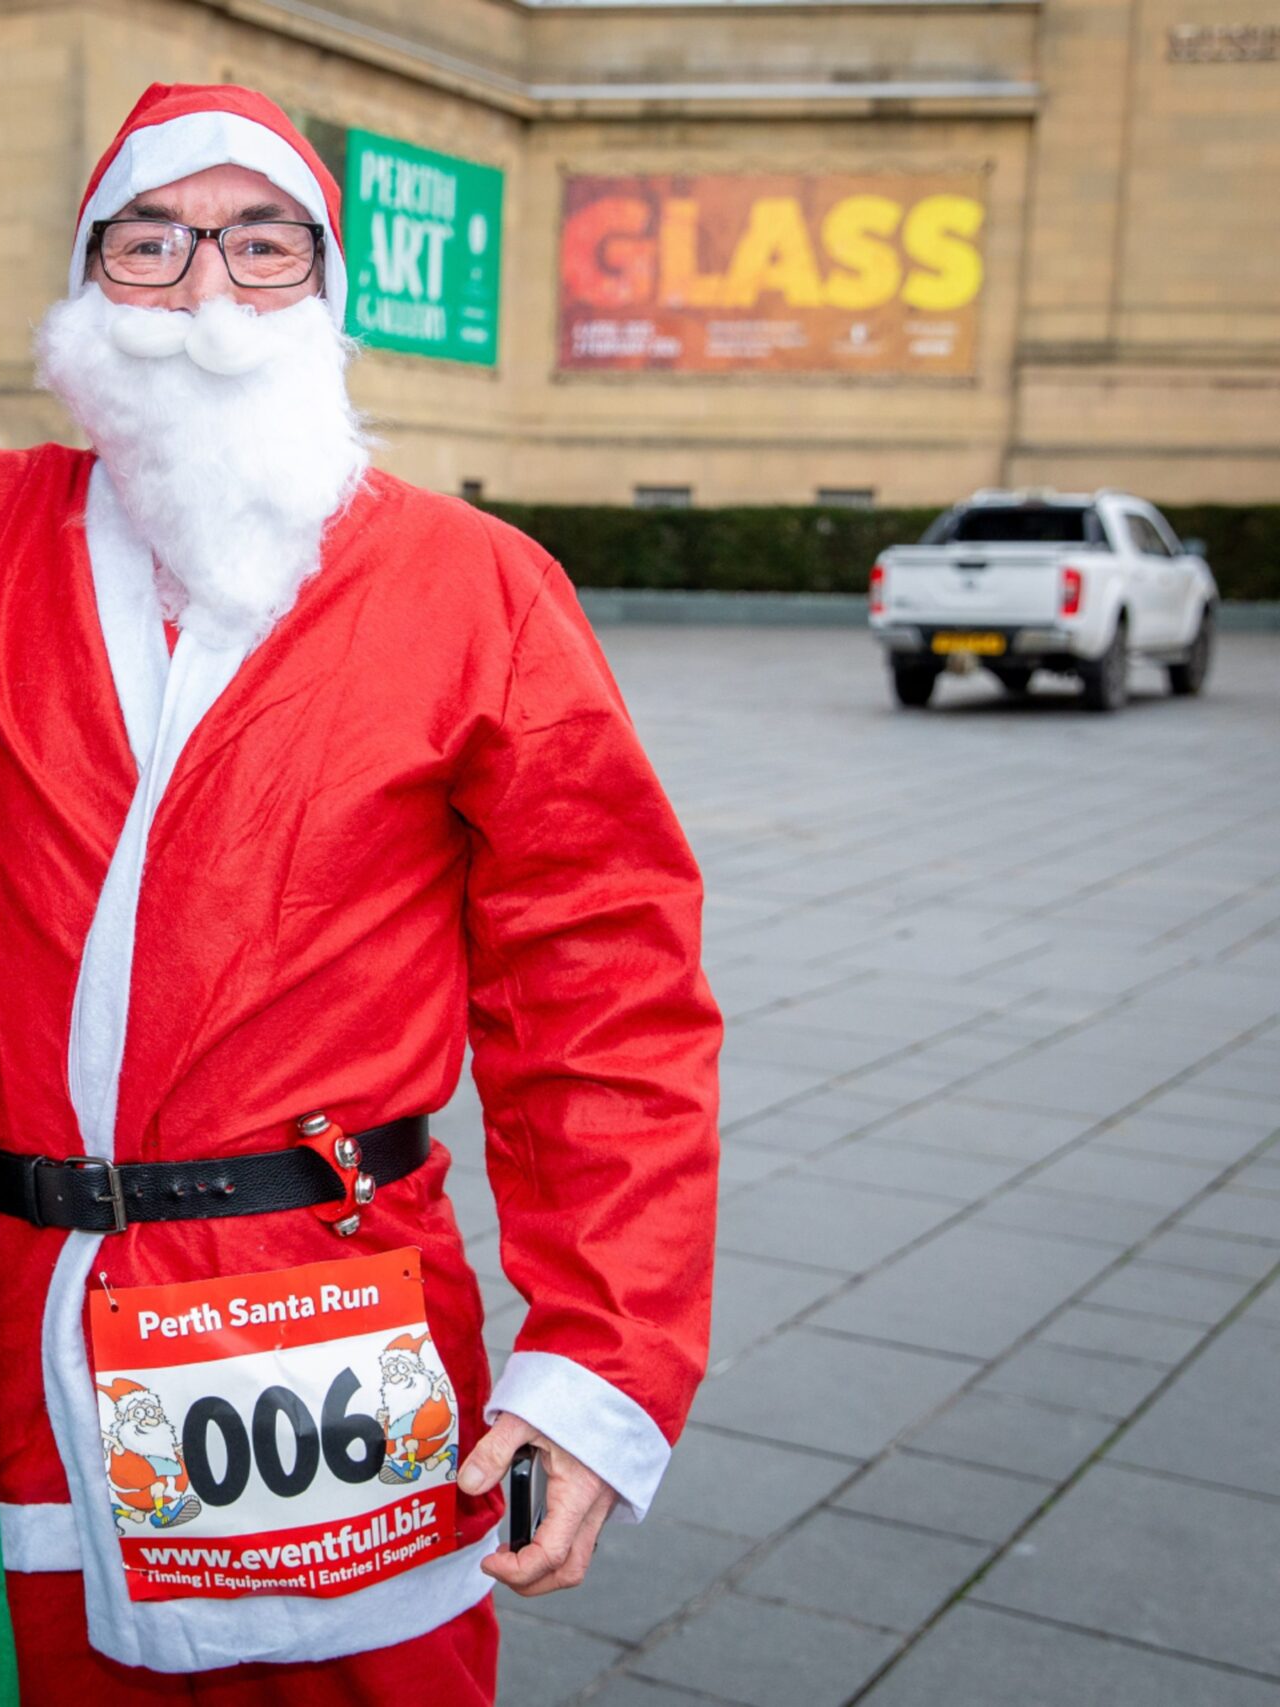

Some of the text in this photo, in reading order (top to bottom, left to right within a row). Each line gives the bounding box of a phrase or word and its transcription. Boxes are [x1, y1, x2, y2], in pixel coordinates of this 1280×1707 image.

[360, 150, 456, 222] PERTH
[359, 211, 454, 301] ART
[562, 194, 985, 311] GLASS
[138, 1284, 379, 1340] Perth Santa Run
[182, 1366, 388, 1507] 006
[140, 1498, 437, 1569] www.eventfull.biz
[214, 1572, 306, 1591] Equipment
[318, 1560, 373, 1586] Entries
